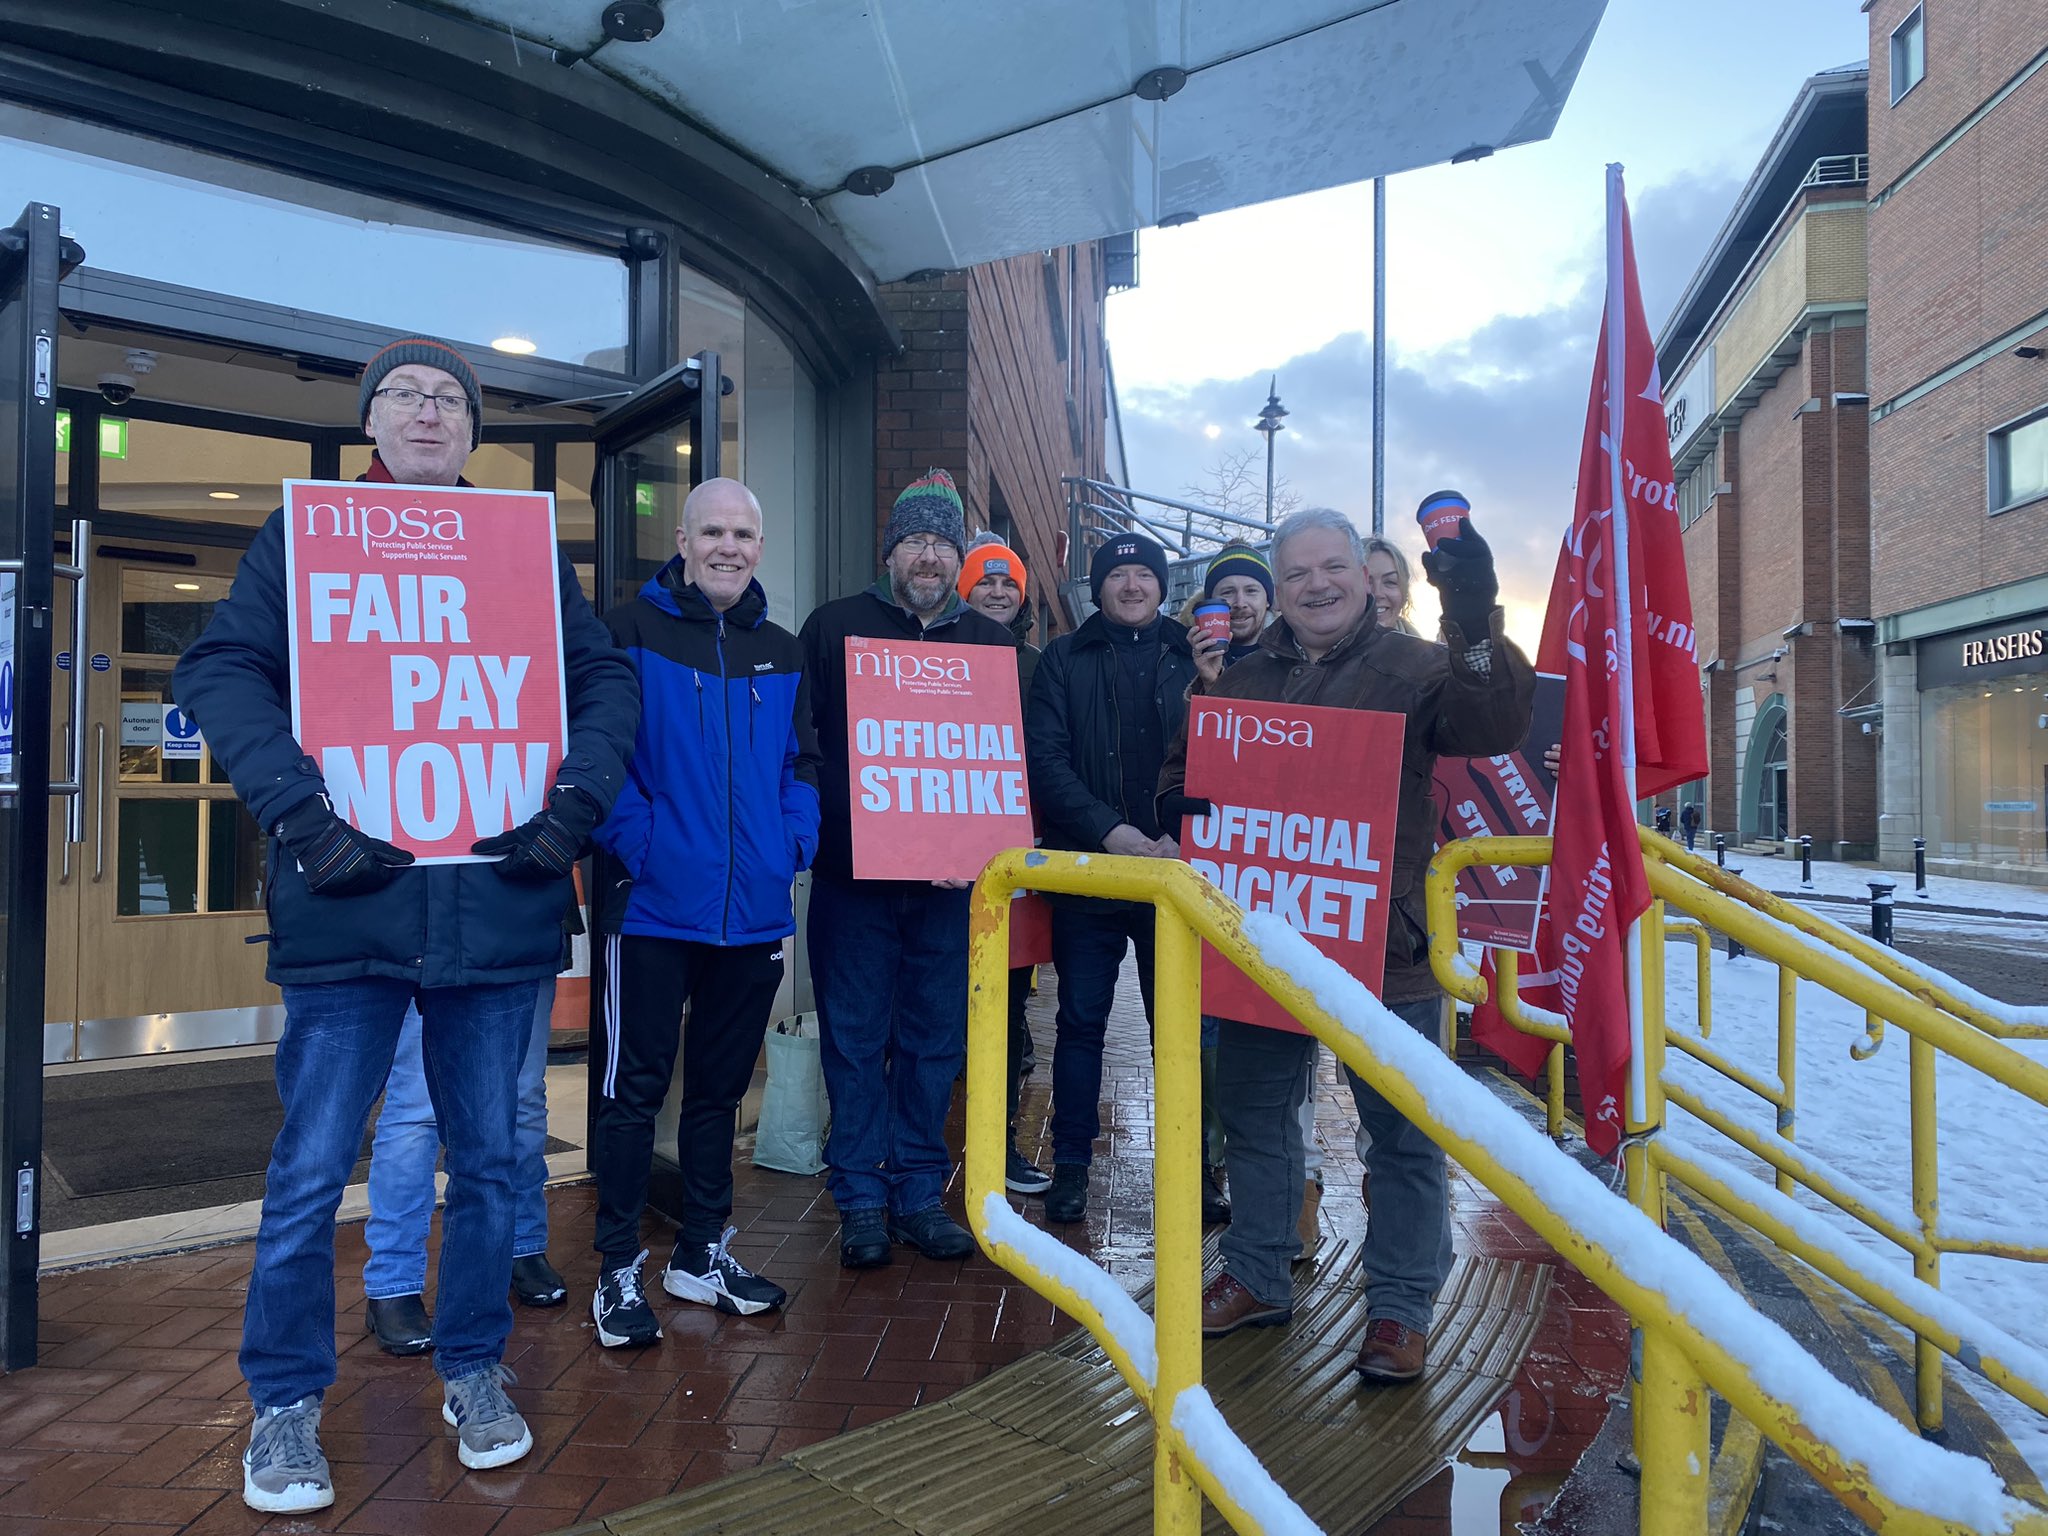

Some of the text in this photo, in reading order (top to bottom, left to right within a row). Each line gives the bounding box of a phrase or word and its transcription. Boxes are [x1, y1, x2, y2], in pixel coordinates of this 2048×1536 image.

[305, 497, 465, 557] nipsa
[371, 540, 453, 551] Protecting Public Services
[382, 551, 418, 560] Supporting
[419, 552, 438, 560] Public
[309, 572, 471, 643] FAIR
[854, 648, 972, 692] nipsa
[1962, 629, 2043, 667] FRASERS
[390, 655, 531, 731] PAY
[122, 717, 160, 725] Automatic
[167, 742, 181, 750] Keep
[855, 718, 1022, 761] OFFICIAL
[1197, 708, 1313, 763] nipsa
[322, 742, 549, 842] NOW
[859, 765, 1027, 816] STRIKE
[1489, 754, 1547, 828] STRYK
[1192, 803, 1380, 872] OFFICIAL
